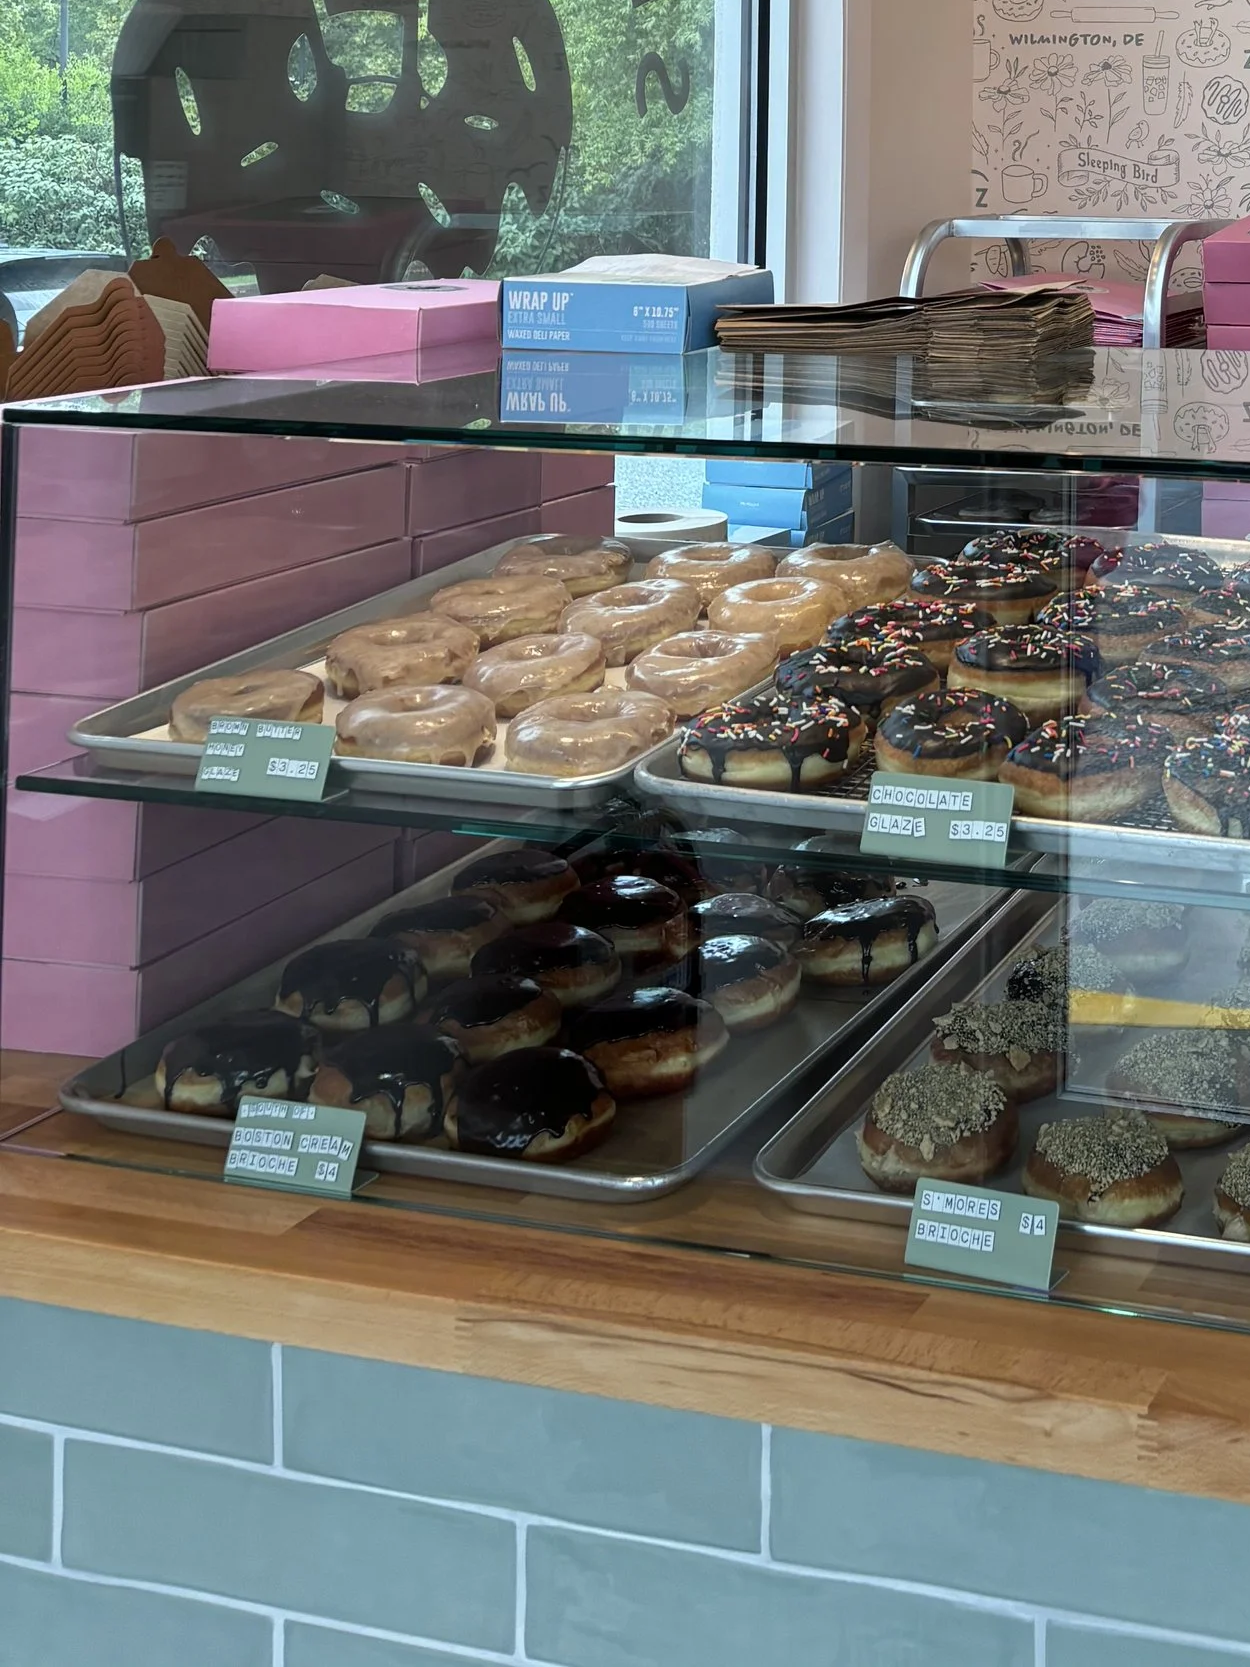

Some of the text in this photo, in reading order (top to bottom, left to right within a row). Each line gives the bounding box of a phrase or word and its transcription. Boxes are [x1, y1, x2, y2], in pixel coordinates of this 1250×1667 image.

[1123, 33, 1145, 46] DE
[1077, 151, 1159, 186] Sleeping Bird
[508, 290, 548, 311] WRAP
[507, 311, 566, 325] EXTRA SMALL
[507, 329, 532, 341] WAXED
[549, 330, 571, 341] PAPER
[267, 758, 319, 778] $3.25
[871, 787, 973, 809] CHOCOLATE
[868, 814, 1007, 840] GLAZE $3.25
[233, 1128, 353, 1160] BOSTON CREAM
[229, 1152, 339, 1180] BRIOCHE $4
[922, 1191, 1046, 1234] S'MORES $4
[916, 1221, 995, 1250] BRIOCHE
